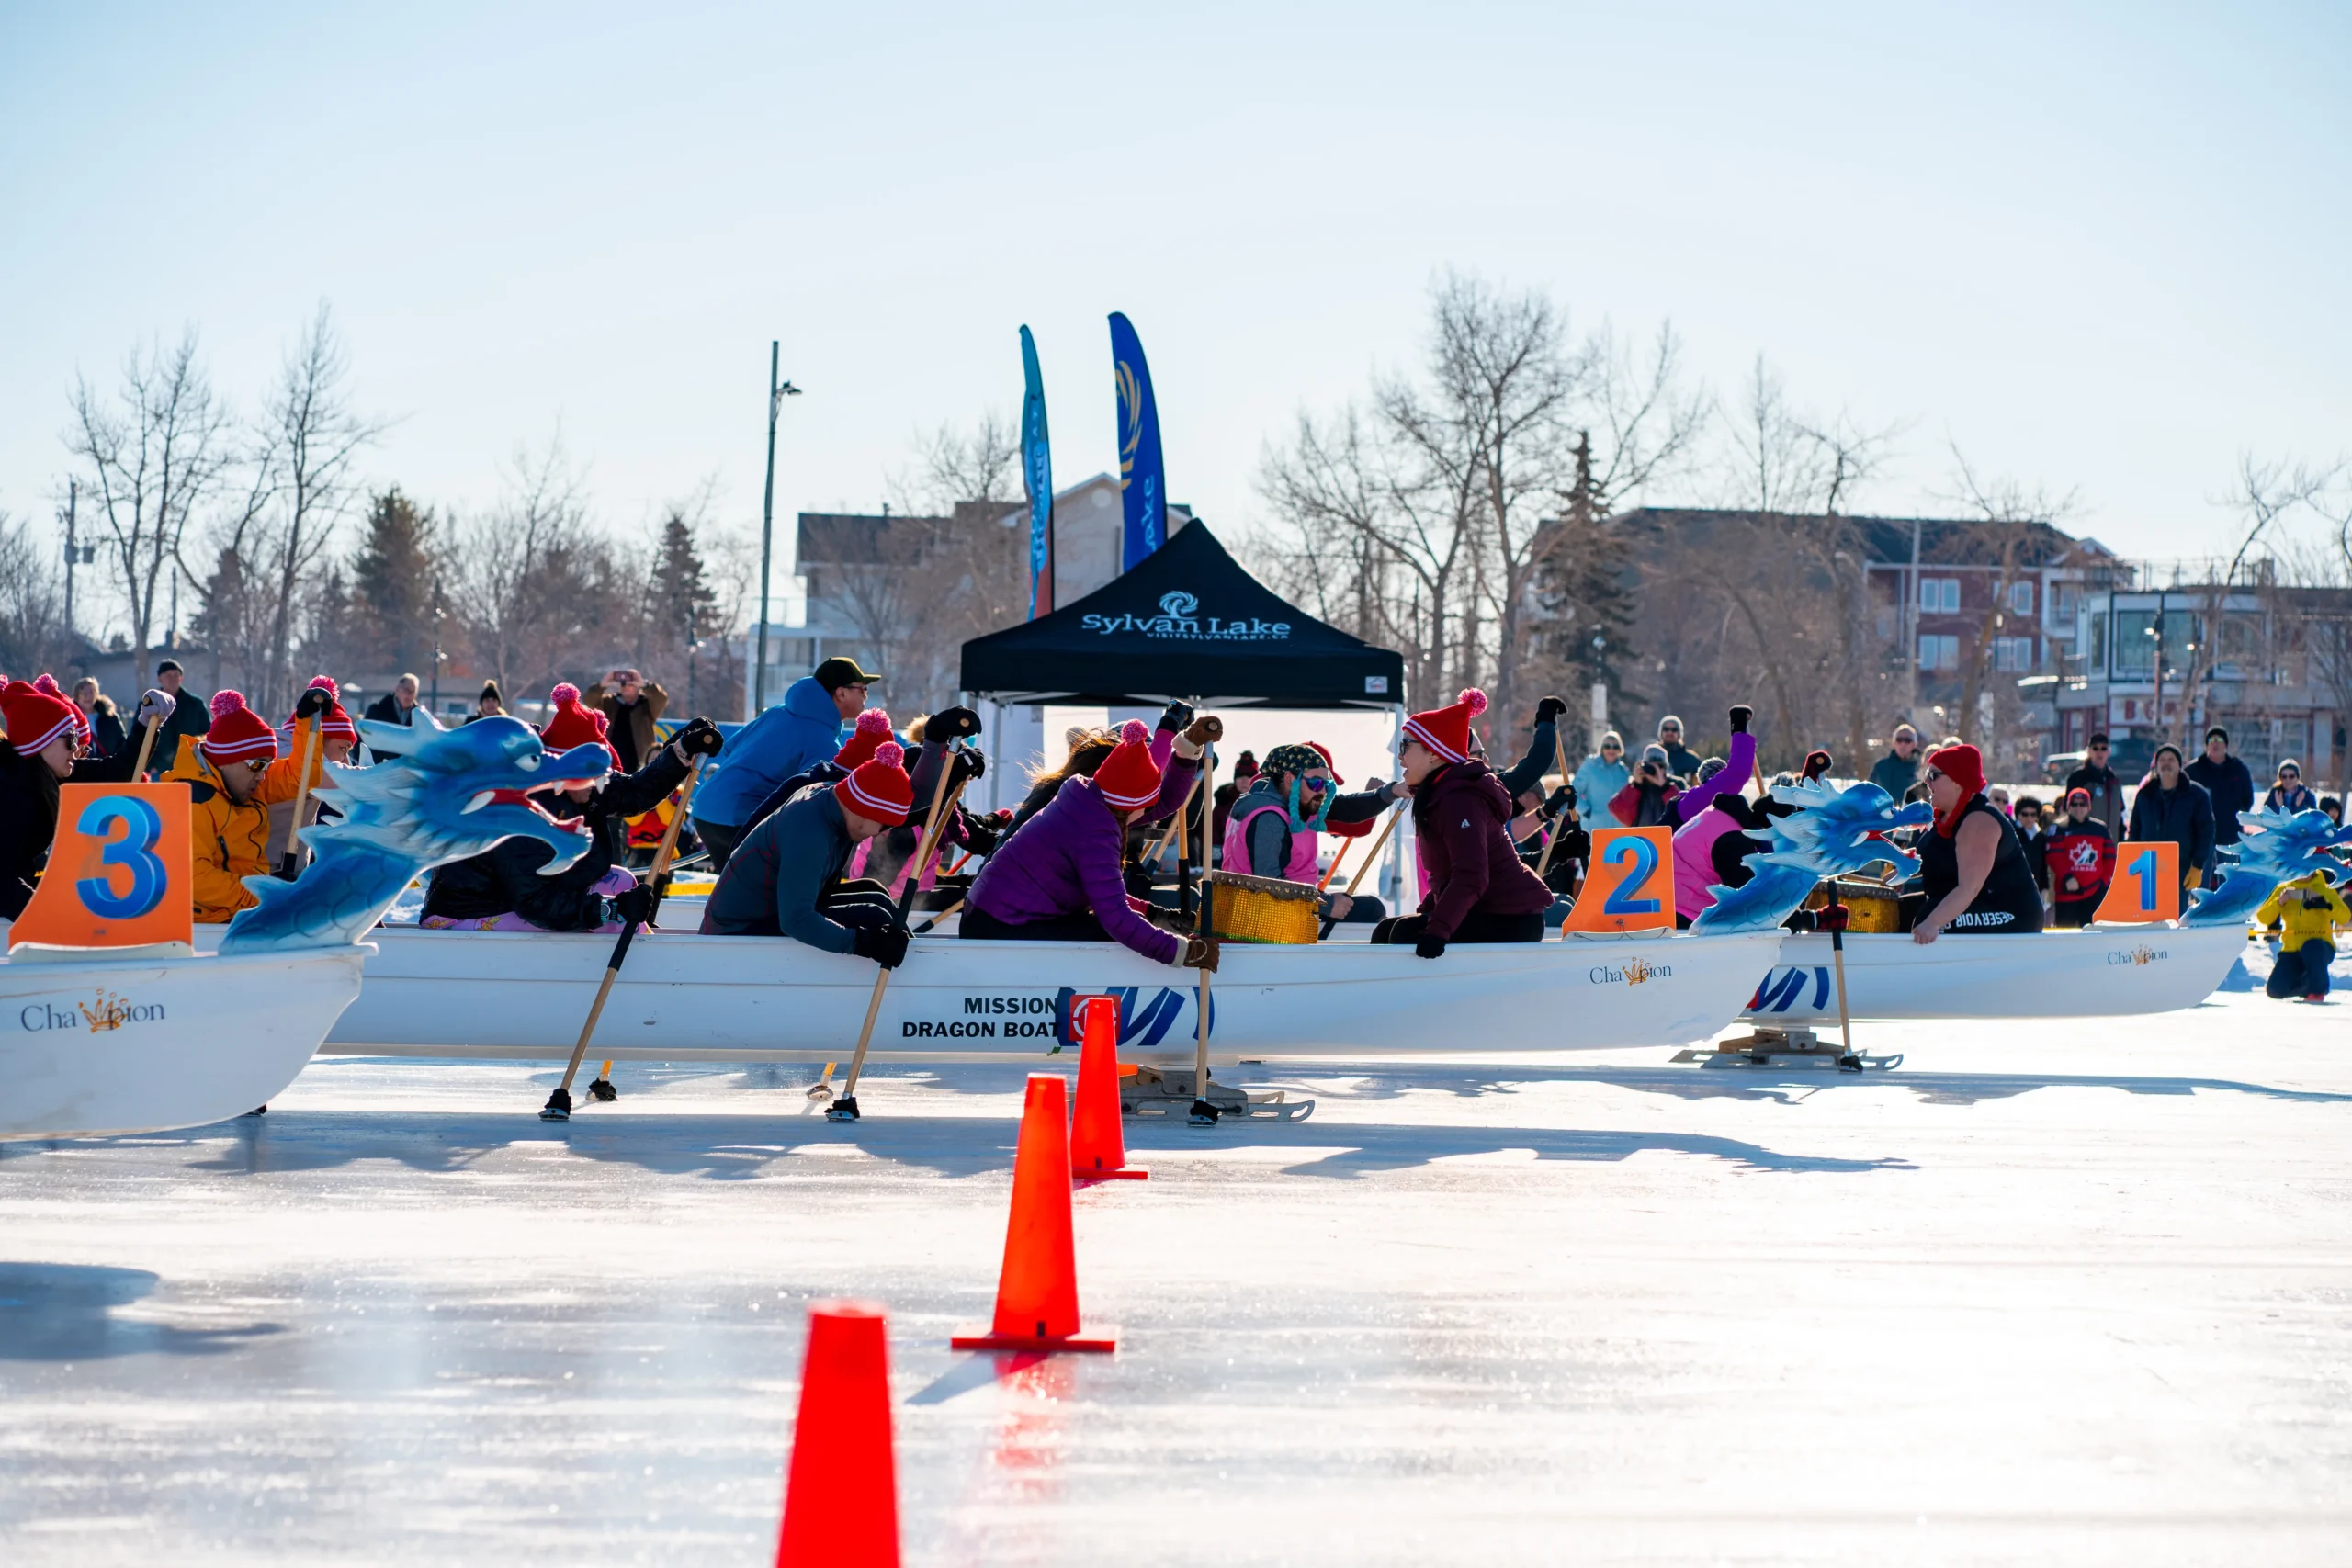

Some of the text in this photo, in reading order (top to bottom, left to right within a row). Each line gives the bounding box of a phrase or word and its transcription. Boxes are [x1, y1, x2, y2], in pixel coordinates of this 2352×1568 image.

[1081, 613, 1292, 637] Sylvan Lake
[75, 795, 168, 919] 3
[1603, 834, 1661, 915] 2
[2128, 850, 2157, 911] 1
[1955, 911, 2016, 929] RESERVOIR
[964, 997, 1058, 1015] MISSION
[902, 1021, 1060, 1038] DRAGON BOAT
